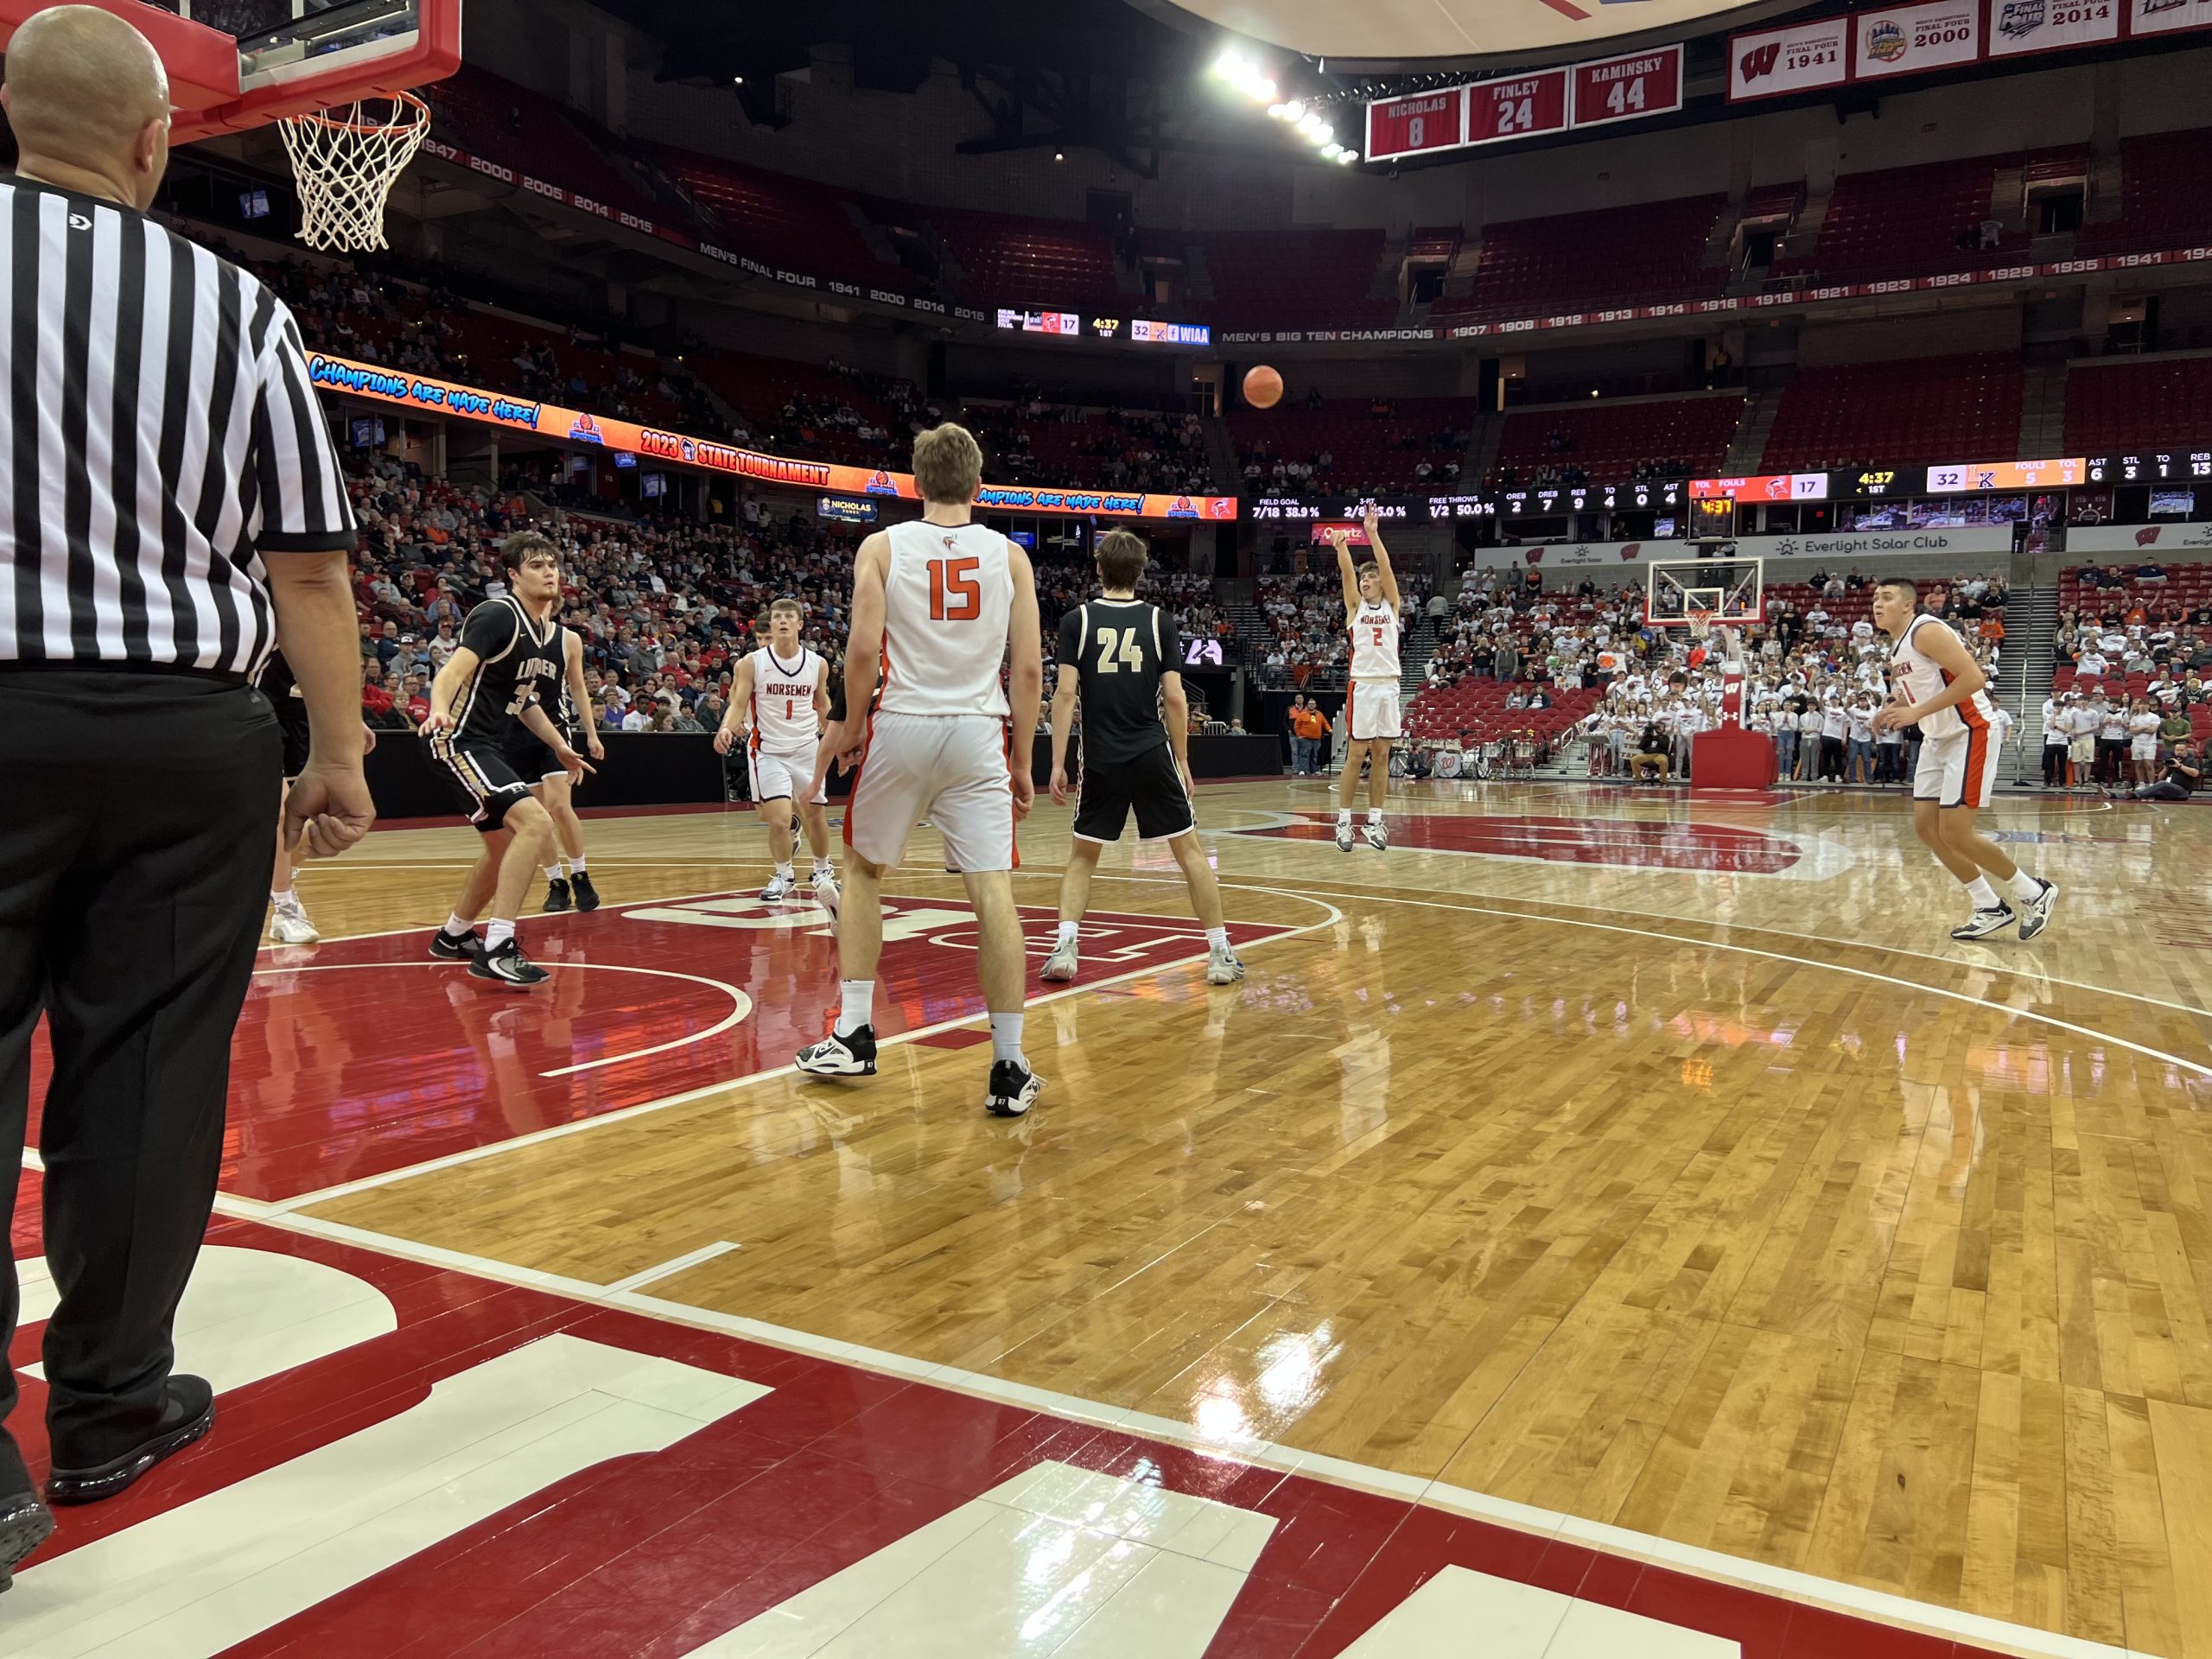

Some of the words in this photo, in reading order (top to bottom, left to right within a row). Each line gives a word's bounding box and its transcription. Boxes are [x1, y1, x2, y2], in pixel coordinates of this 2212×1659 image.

[2013, 1, 2045, 15] FINAL
[2052, 1, 2081, 10] FINAL
[1999, 11, 2044, 30] FOUR
[2053, 5, 2109, 26] 2014
[1916, 23, 1942, 32] FINAL
[1944, 18, 1970, 28] FOUR
[1915, 28, 1970, 48] 2000
[1815, 41, 1838, 50] FOUR
[1740, 42, 1780, 84] W
[1788, 50, 1837, 69] 1941
[1592, 56, 1662, 84] KAMINSKY
[1494, 79, 1540, 101] FINLEY
[1607, 78, 1645, 113] 44
[1389, 97, 1446, 118] NICHOLAS
[1497, 102, 1533, 133] 24
[421, 138, 457, 160] 1947
[471, 156, 513, 182] 2000
[524, 176, 563, 200] 2005
[575, 195, 608, 217] 2014
[620, 213, 652, 233] 2015
[700, 242, 737, 264] MEN'S
[741, 258, 772, 278] FINAL
[777, 270, 816, 288] FOUR
[829, 282, 861, 296] 1941
[870, 289, 905, 305] 2000
[914, 299, 945, 314] 2014
[954, 308, 984, 322] 2015
[1223, 332, 1270, 342] MEN'S
[1276, 331, 1301, 342] BIG
[1306, 331, 1336, 341] TEN
[1340, 328, 1433, 340] CHAMPIONS
[1452, 325, 1487, 337] 1907
[1498, 320, 1534, 333] 1908
[1548, 315, 1583, 327] 1912
[1597, 308, 1632, 321] 1913
[1648, 303, 1684, 317] 1914
[1700, 297, 1738, 311] 1916
[1755, 292, 1794, 306] 1918
[1810, 286, 1850, 300] 1921
[1867, 279, 1910, 295] 1923
[1927, 272, 1971, 288] 1924
[1987, 265, 2034, 281] 1929
[2050, 259, 2099, 274] 1935
[2116, 252, 2163, 268] 1941
[2183, 246, 2212, 261] 194
[1064, 320, 1075, 329] 17
[1092, 318, 1119, 330] 4:37
[1135, 326, 1148, 336] 32
[1180, 327, 1208, 343] WIAA
[309, 354, 407, 397] CHAMPIONS
[411, 380, 445, 405] ARE
[447, 391, 489, 415] MADE
[493, 402, 540, 429] HERE!
[640, 429, 679, 460] 2023
[697, 442, 737, 470] STATE
[737, 451, 830, 486] TOURNAMENT
[2088, 458, 2107, 467] AST
[2122, 456, 2140, 465] STL
[2190, 453, 2211, 461] REB
[2015, 461, 2046, 471] FOULS
[2059, 459, 2078, 469] TOL
[2159, 464, 2168, 477] 1
[2191, 462, 2212, 475] 13
[1859, 471, 1894, 484] 4:37
[2025, 472, 2037, 484] 5
[2063, 470, 2073, 482] 3
[2090, 467, 2103, 481] 6
[2124, 466, 2137, 479] 3
[1936, 474, 1959, 486] 32
[1800, 481, 1816, 493] 17
[1867, 485, 1885, 493] 1ST
[1538, 490, 1558, 499] DREB
[1637, 494, 1648, 505] 0
[1665, 493, 1676, 504] 4
[831, 500, 871, 512] NICHOLAS
[1037, 492, 1063, 507] ARE
[1065, 494, 1100, 511] MADE
[1103, 493, 1146, 514] HERE!
[1512, 501, 1521, 512] 2
[1543, 499, 1552, 511] 7
[1574, 498, 1584, 509] 9
[1605, 496, 1615, 507] 4
[1701, 499, 1732, 513] 4:37
[1253, 506, 1280, 518] 7/18
[1344, 506, 1365, 518] 2/8
[1429, 505, 1449, 518] 1/2
[1805, 539, 1868, 553] Everlight
[1872, 537, 1910, 550] Solar
[1913, 536, 1948, 548] Club
[925, 556, 980, 620] 15
[1372, 627, 1383, 646] 2
[1097, 627, 1143, 674] 24
[766, 683, 811, 696] NORSEMEN
[786, 700, 793, 720] 1
